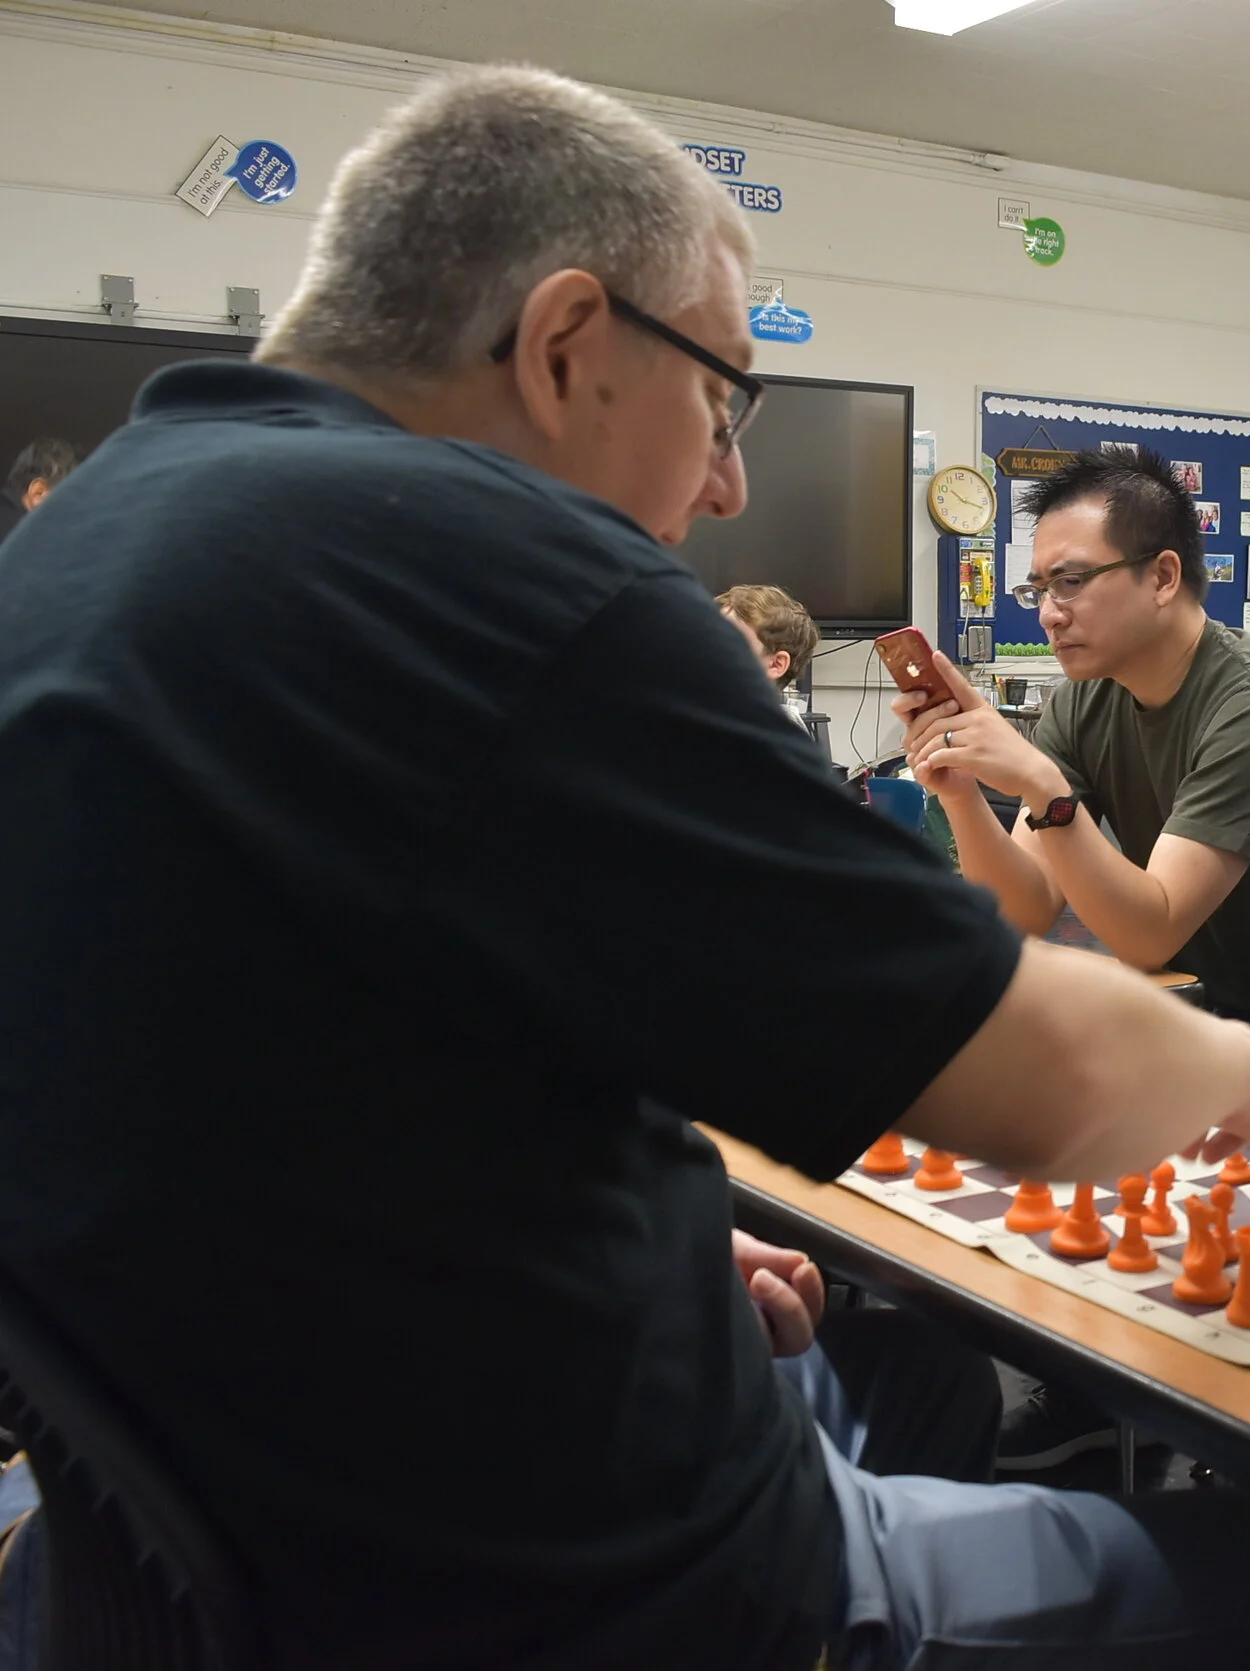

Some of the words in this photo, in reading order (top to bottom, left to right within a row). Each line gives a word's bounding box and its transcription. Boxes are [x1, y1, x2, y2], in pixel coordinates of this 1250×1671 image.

[243, 164, 258, 180] I'm
[253, 147, 270, 167] just
[685, 147, 743, 173] DSET
[188, 183, 203, 199] I'm
[199, 169, 214, 186] not
[210, 147, 230, 172] good
[254, 156, 281, 188] getting
[264, 164, 290, 194] started.
[200, 191, 211, 205] at
[1008, 206, 1024, 214] can't
[1004, 213, 1013, 221] do
[1034, 228, 1046, 237] I'm
[1047, 230, 1056, 238] on
[1043, 239, 1060, 249] right
[752, 284, 773, 294] good
[771, 313, 785, 322] this
[759, 322, 777, 332] best
[778, 325, 803, 335] work?
[946, 476, 953, 485] 11
[955, 472, 965, 481] 12
[938, 485, 949, 493] 10
[937, 495, 944, 504] 9
[981, 497, 988, 505] 3
[941, 508, 948, 516] 8
[951, 516, 958, 524] 7
[962, 521, 969, 529] 6
